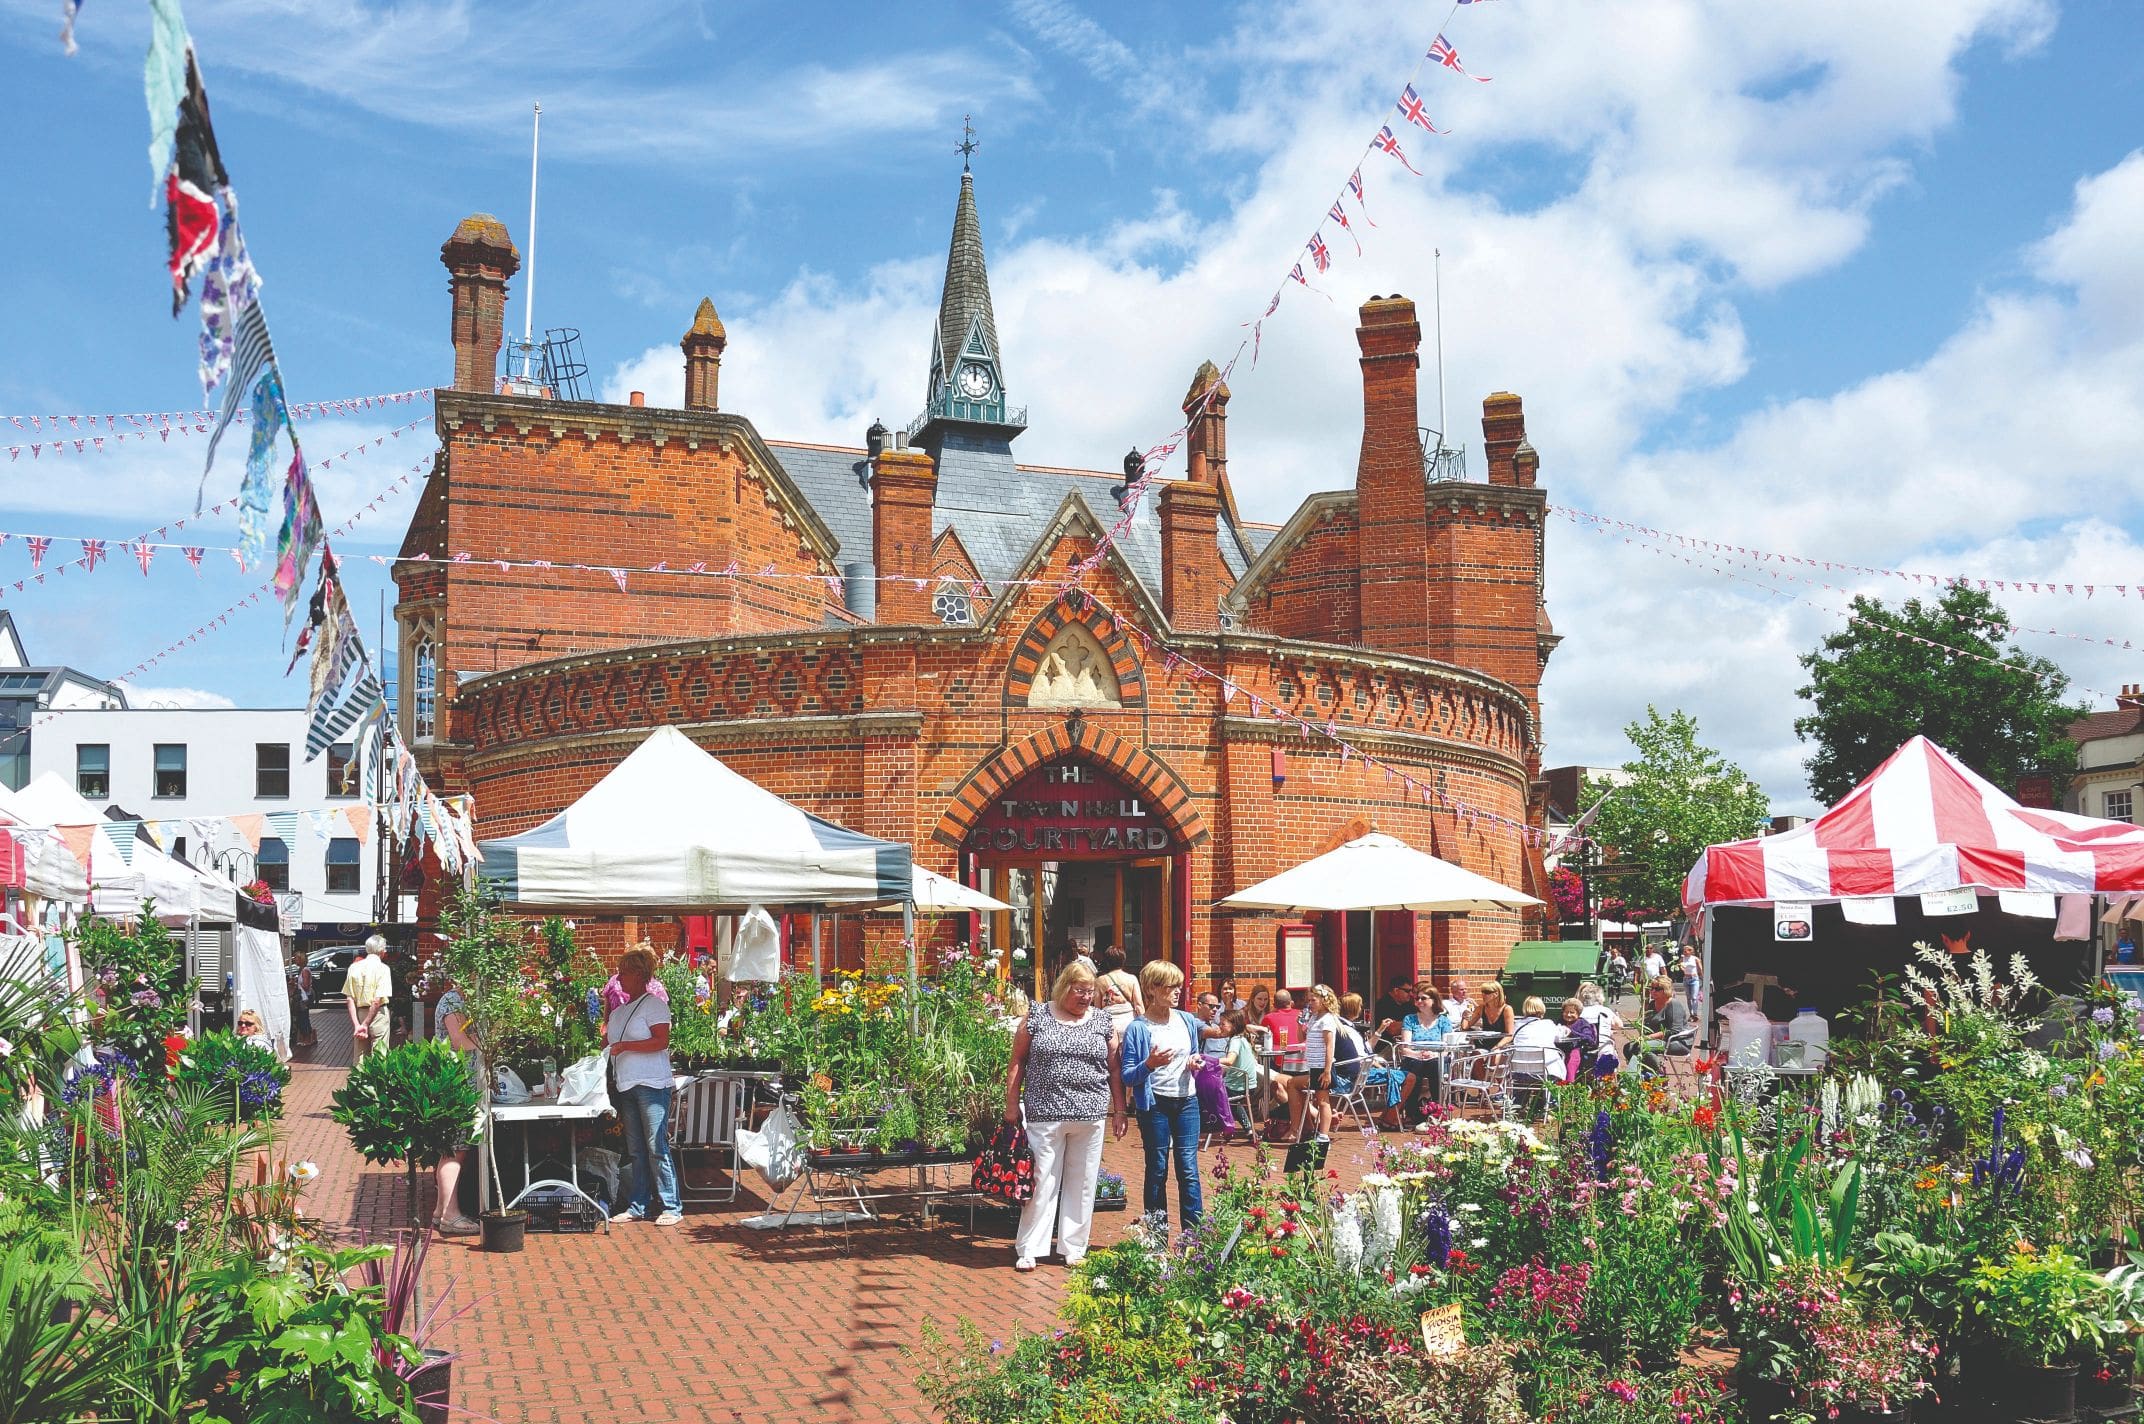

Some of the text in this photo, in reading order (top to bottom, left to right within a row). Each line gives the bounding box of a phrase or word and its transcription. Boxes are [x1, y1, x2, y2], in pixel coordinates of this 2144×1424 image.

[1044, 766, 1095, 784] THE
[967, 827, 1169, 850] COURTYARD
[1947, 903, 1973, 912] £2.50
[1427, 1314, 1459, 1331] FUCHSIA
